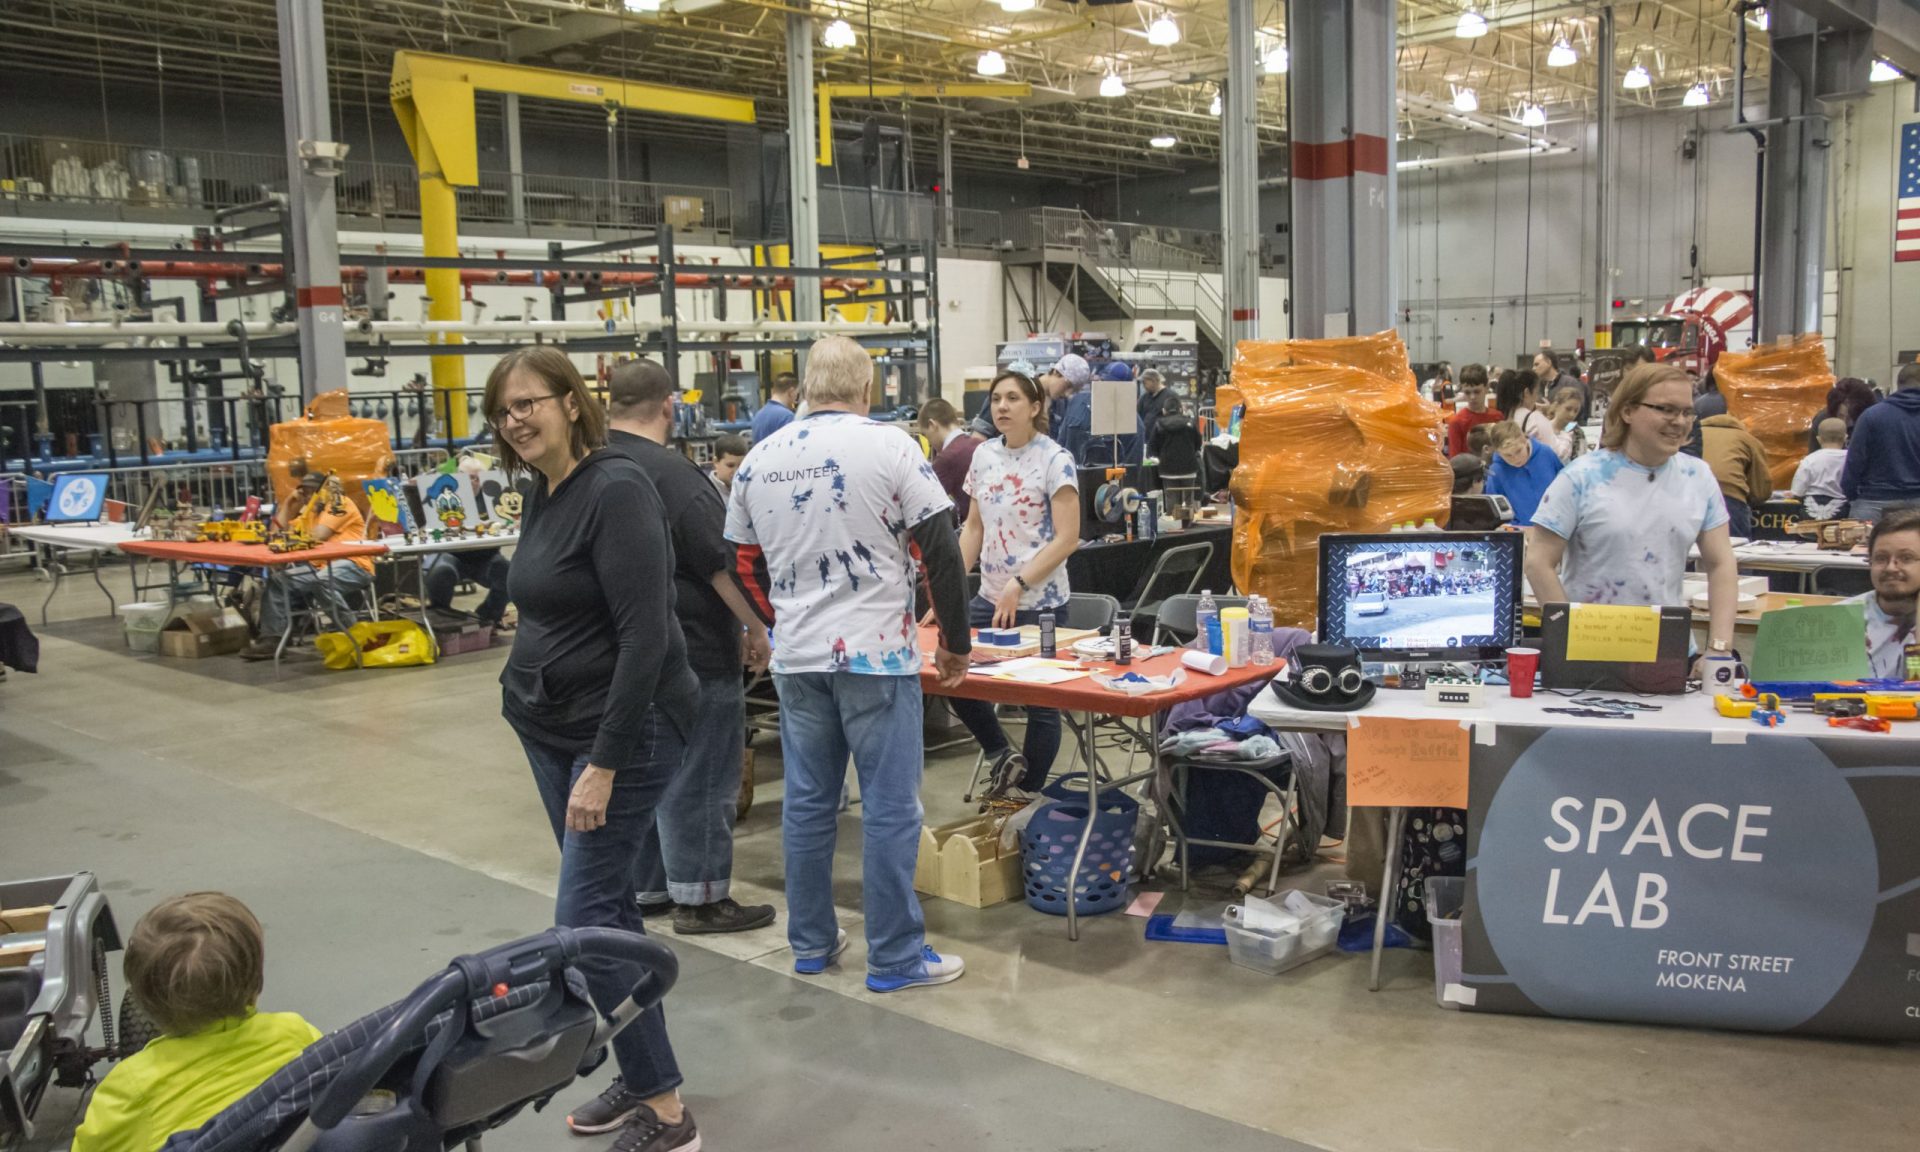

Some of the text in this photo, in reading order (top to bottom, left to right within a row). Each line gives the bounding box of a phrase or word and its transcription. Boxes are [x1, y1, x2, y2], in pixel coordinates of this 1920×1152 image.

[761, 464, 841, 484] VOLUNTEER
[1543, 796, 1772, 862] SPACE
[1542, 867, 1669, 929] LAB
[1657, 949, 1795, 973] FRONT STREET
[1656, 972, 1747, 992] MOKENA
